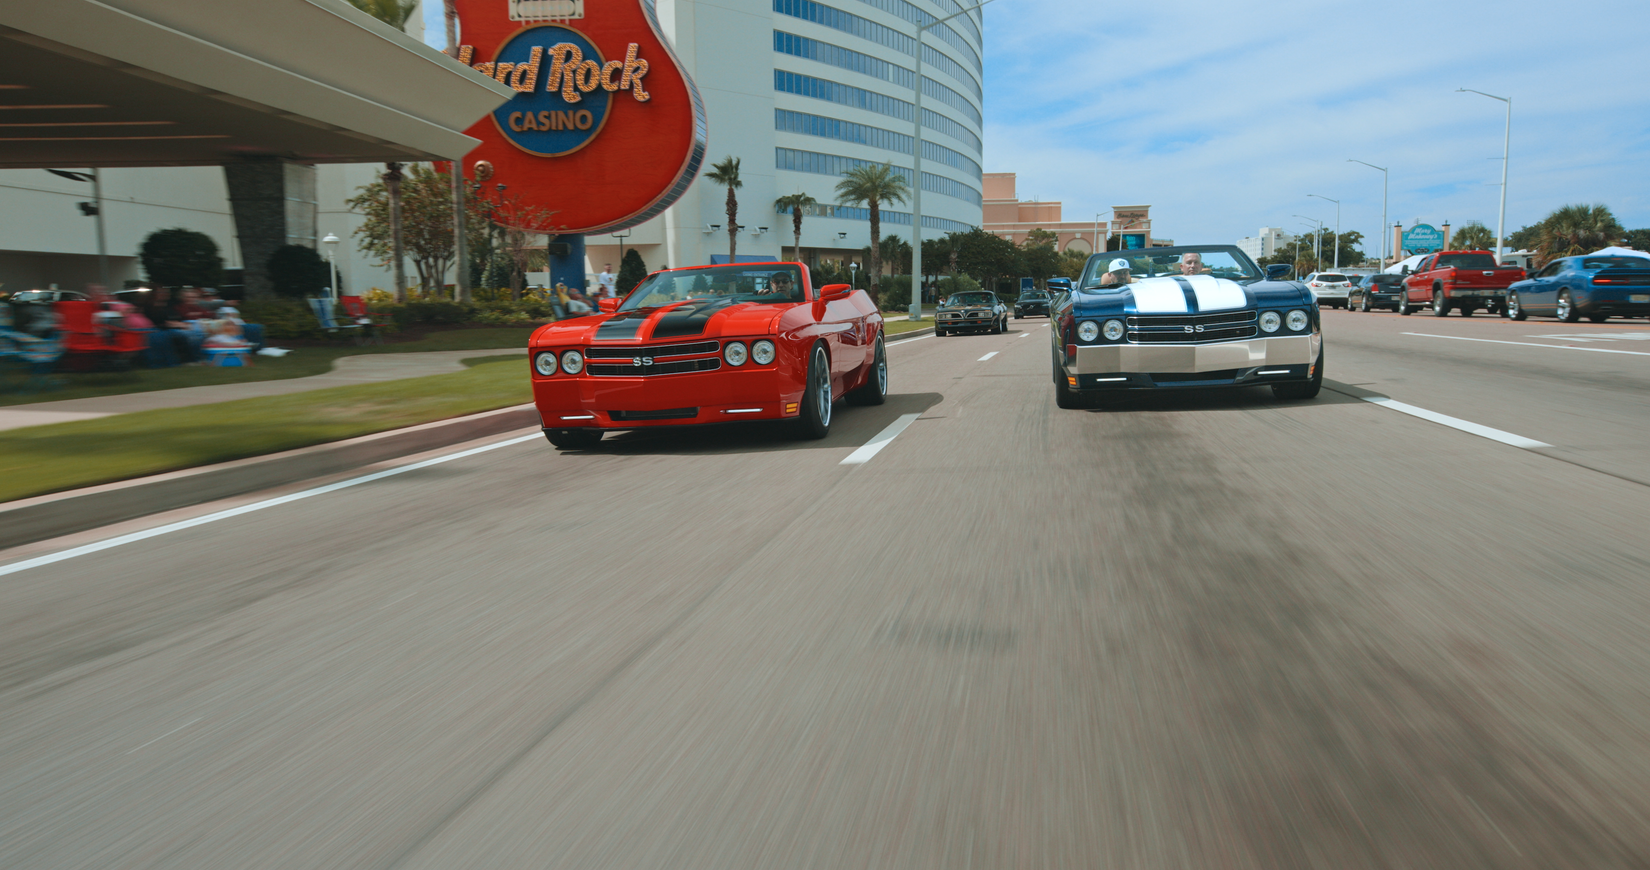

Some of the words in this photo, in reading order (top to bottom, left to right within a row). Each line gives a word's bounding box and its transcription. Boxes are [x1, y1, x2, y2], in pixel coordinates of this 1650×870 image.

[441, 45, 543, 92] ard
[546, 42, 650, 103] Rock
[508, 109, 593, 132] CASINO
[1184, 324, 1205, 333] SS
[633, 356, 653, 366] SS
